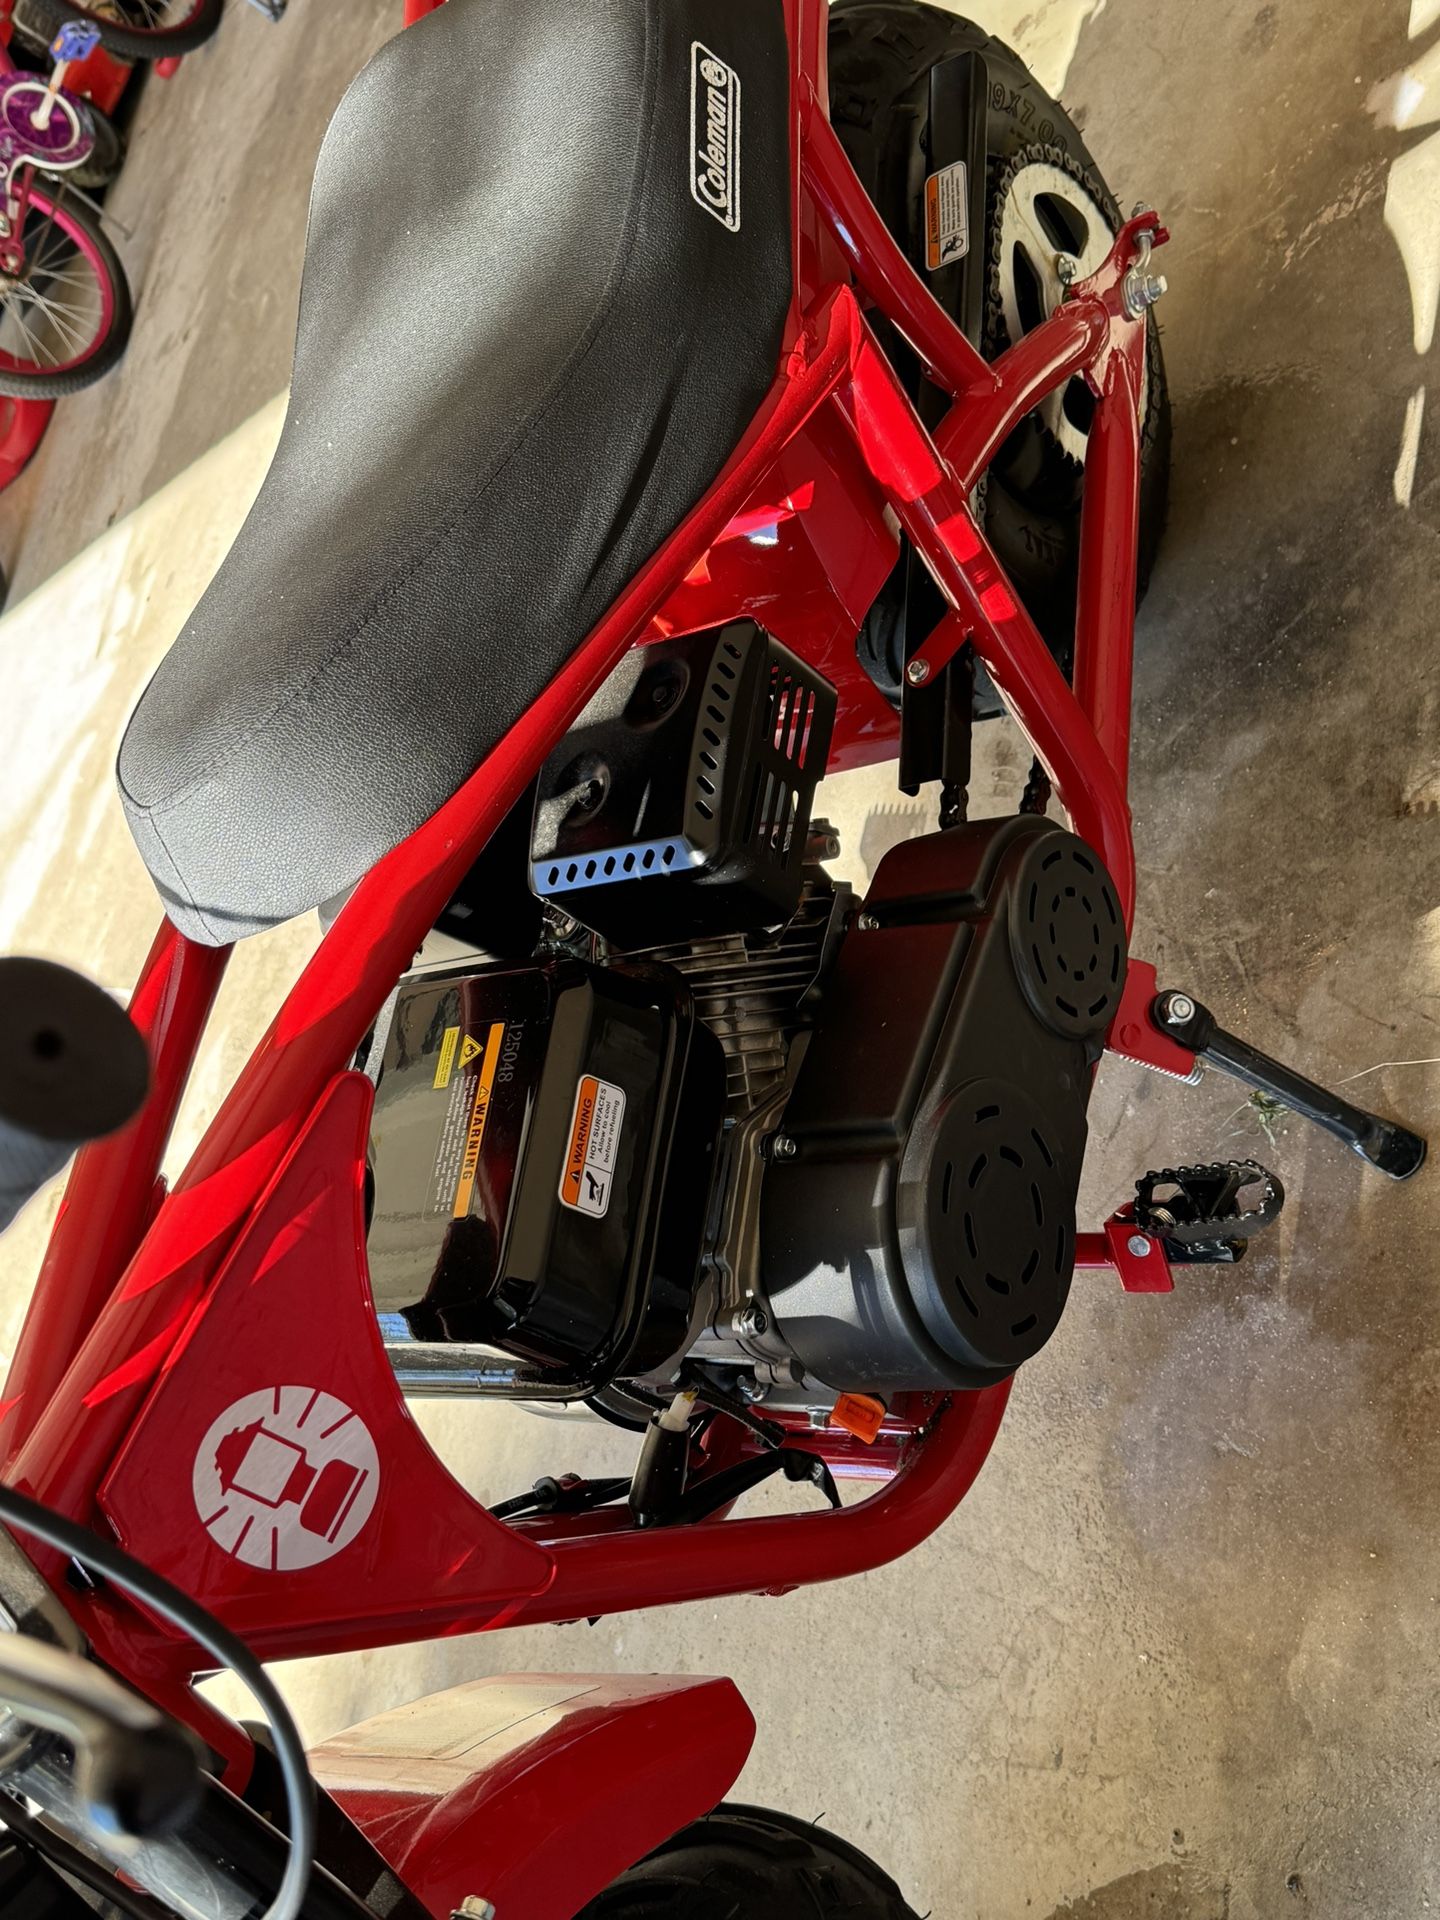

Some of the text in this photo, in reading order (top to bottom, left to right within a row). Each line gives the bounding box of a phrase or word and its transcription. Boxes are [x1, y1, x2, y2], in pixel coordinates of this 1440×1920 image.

[697, 85, 726, 206] Coleman
[497, 1020, 525, 1084] 125048
[461, 1102, 486, 1180] WARNING
[573, 1097, 592, 1163] WARNING
[589, 1088, 606, 1159] HOT SURFACES
[597, 1131, 606, 1153] Allow
[602, 1120, 607, 1128] to
[604, 1100, 620, 1162] before refueling
